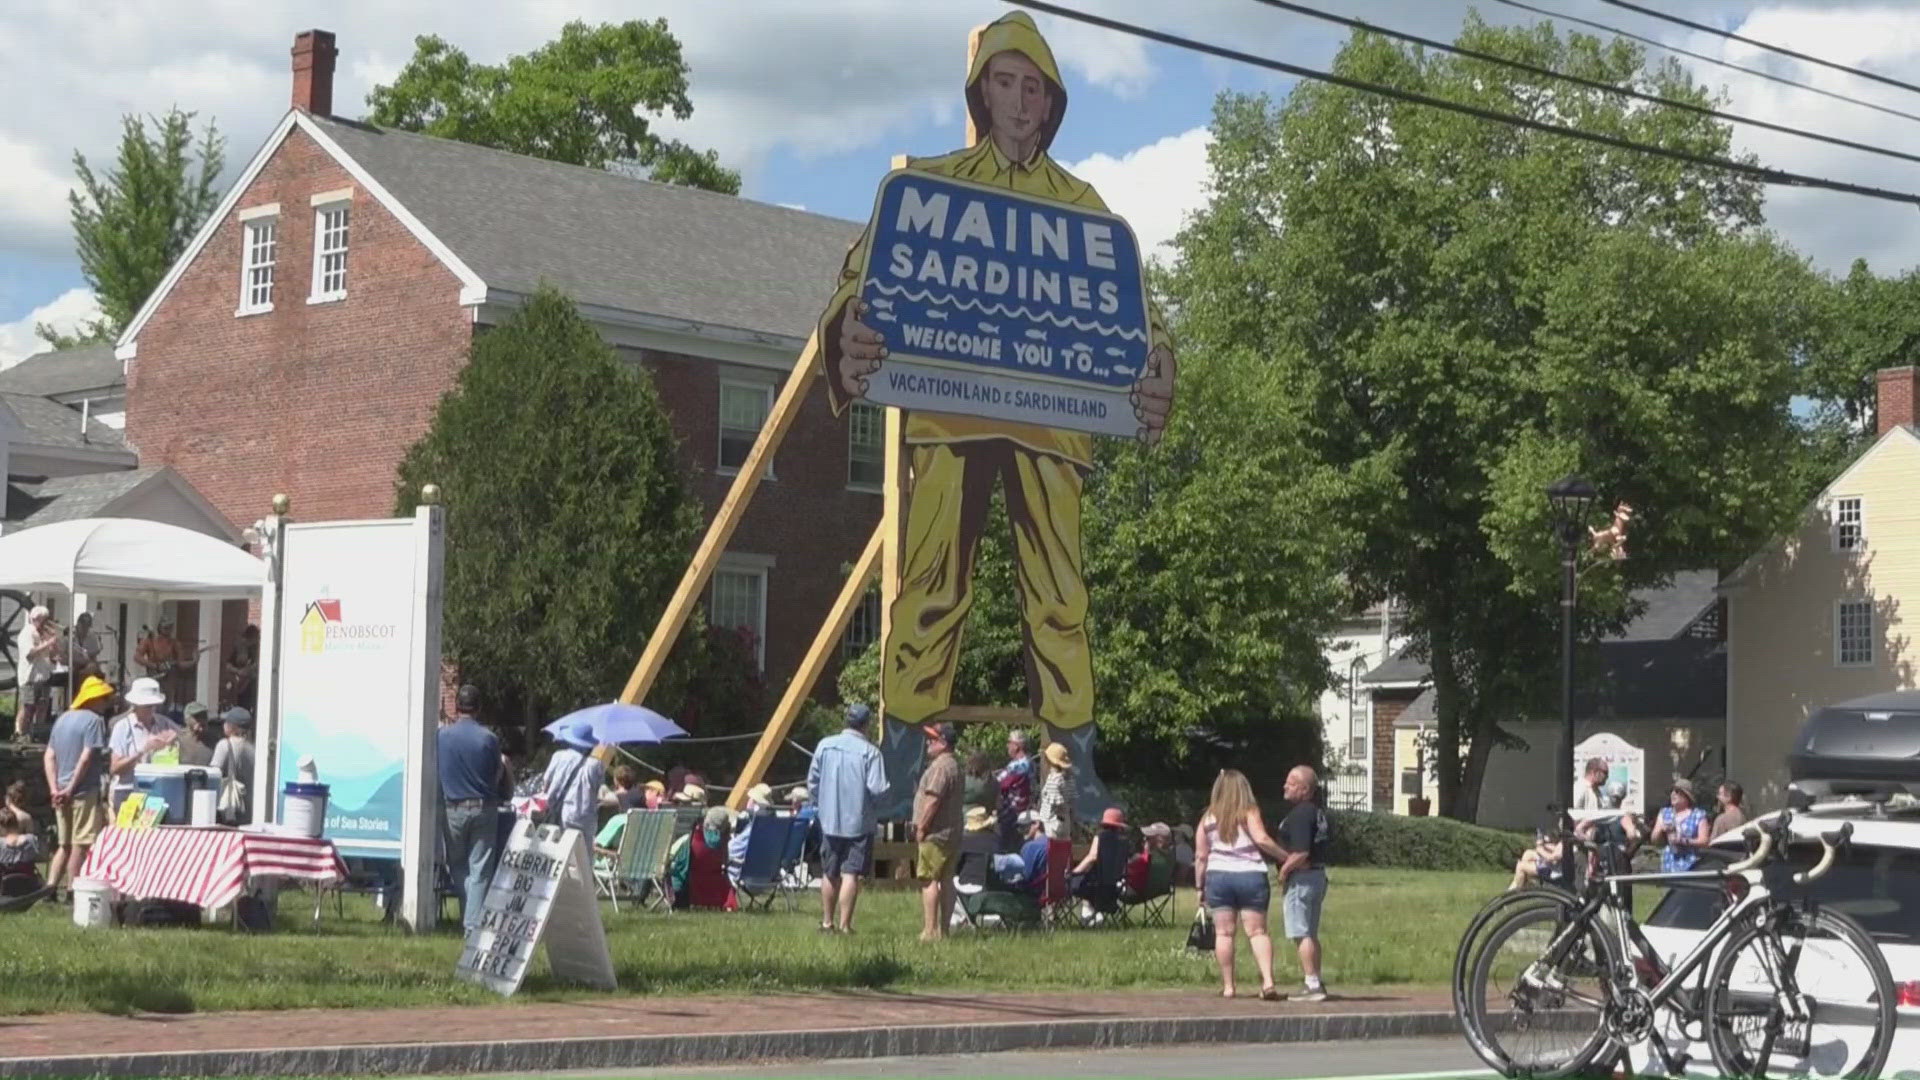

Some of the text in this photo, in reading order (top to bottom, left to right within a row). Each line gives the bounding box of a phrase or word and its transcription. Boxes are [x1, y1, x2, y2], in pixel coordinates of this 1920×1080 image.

[895, 187, 1116, 271] MAINE
[889, 243, 1119, 315] SARDINES
[902, 324, 1110, 377] WELCOME YOU TO...
[889, 372, 1001, 404] VACATIONLAND
[1014, 392, 1107, 419] SARDINELAND
[325, 624, 396, 639] PENOBSCOT
[330, 813, 341, 829] of
[341, 815, 358, 830] Sea
[358, 816, 389, 832] Stories
[513, 873, 534, 893] BIG
[481, 909, 509, 930] SAT
[472, 949, 511, 976] HERE
